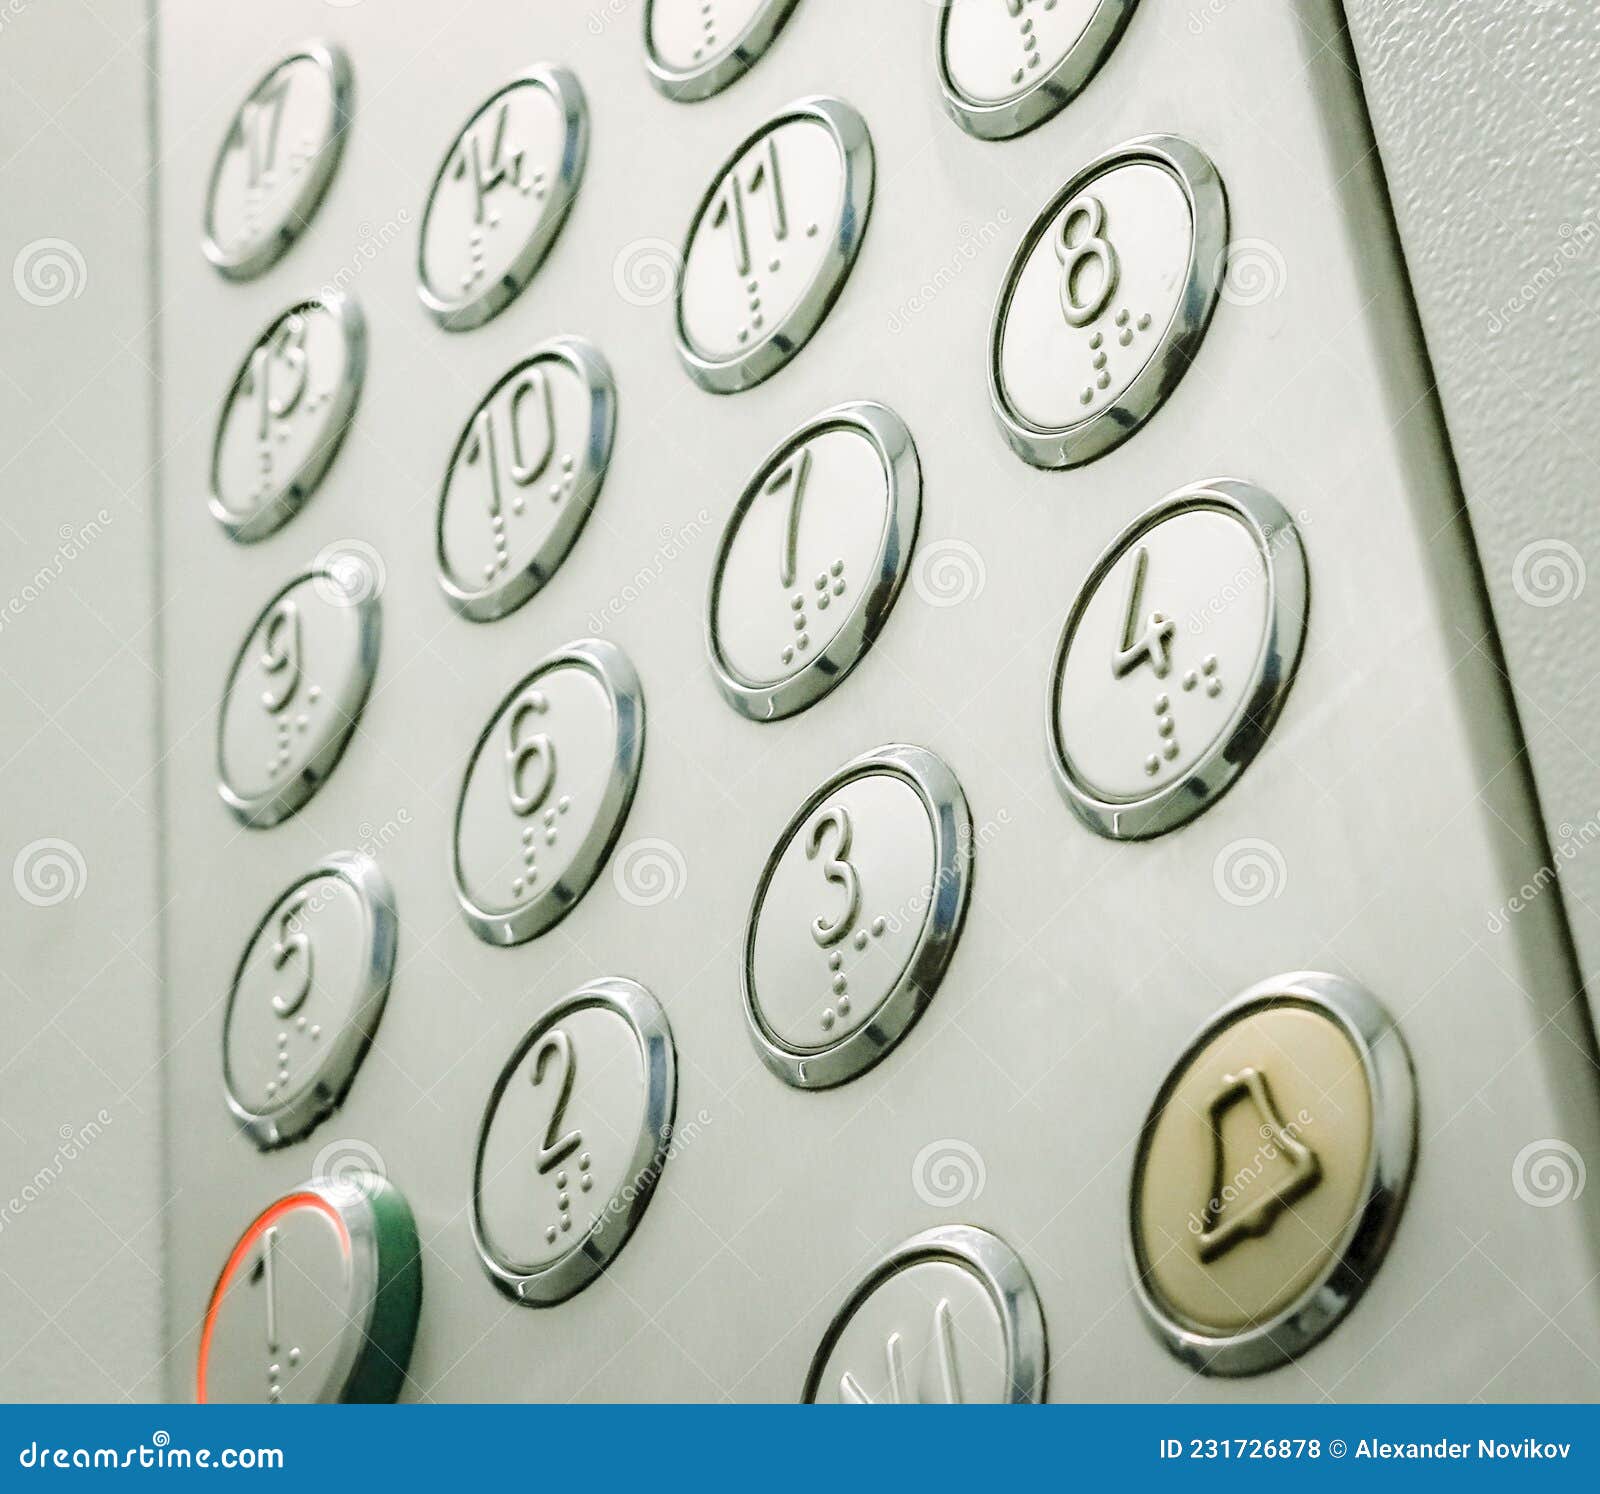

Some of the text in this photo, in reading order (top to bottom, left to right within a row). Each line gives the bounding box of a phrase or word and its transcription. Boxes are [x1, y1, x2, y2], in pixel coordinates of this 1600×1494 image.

[453, 102, 526, 224] 14
[712, 137, 788, 276] 11
[1055, 195, 1121, 328] 8
[469, 367, 556, 517] 10
[261, 599, 302, 713] 9
[1112, 545, 1176, 680] 4
[506, 691, 557, 818] 6
[807, 806, 862, 948] 3
[271, 891, 314, 1018] 5
[531, 1028, 582, 1174] 2
[249, 1225, 279, 1354] 1
